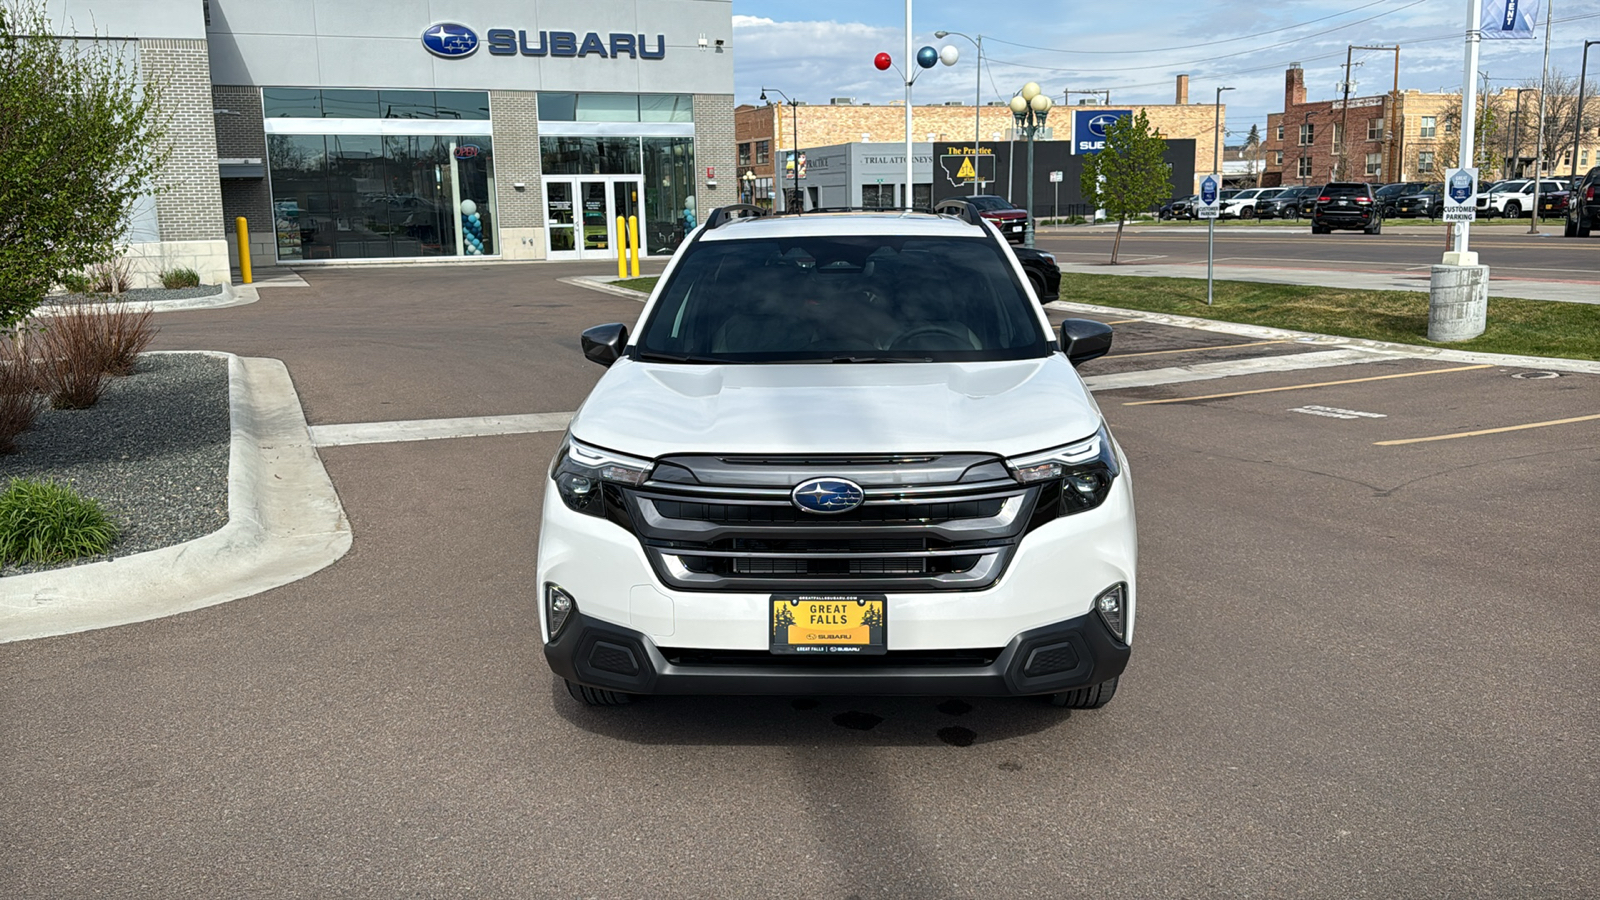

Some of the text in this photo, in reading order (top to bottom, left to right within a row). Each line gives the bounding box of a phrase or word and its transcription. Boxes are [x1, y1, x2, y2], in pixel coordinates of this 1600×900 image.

[1506, 0, 1515, 25] ENT
[487, 28, 665, 59] SUBARU
[947, 146, 991, 154] The Pratice
[810, 605, 847, 613] GREAT
[810, 615, 847, 624] FALLS
